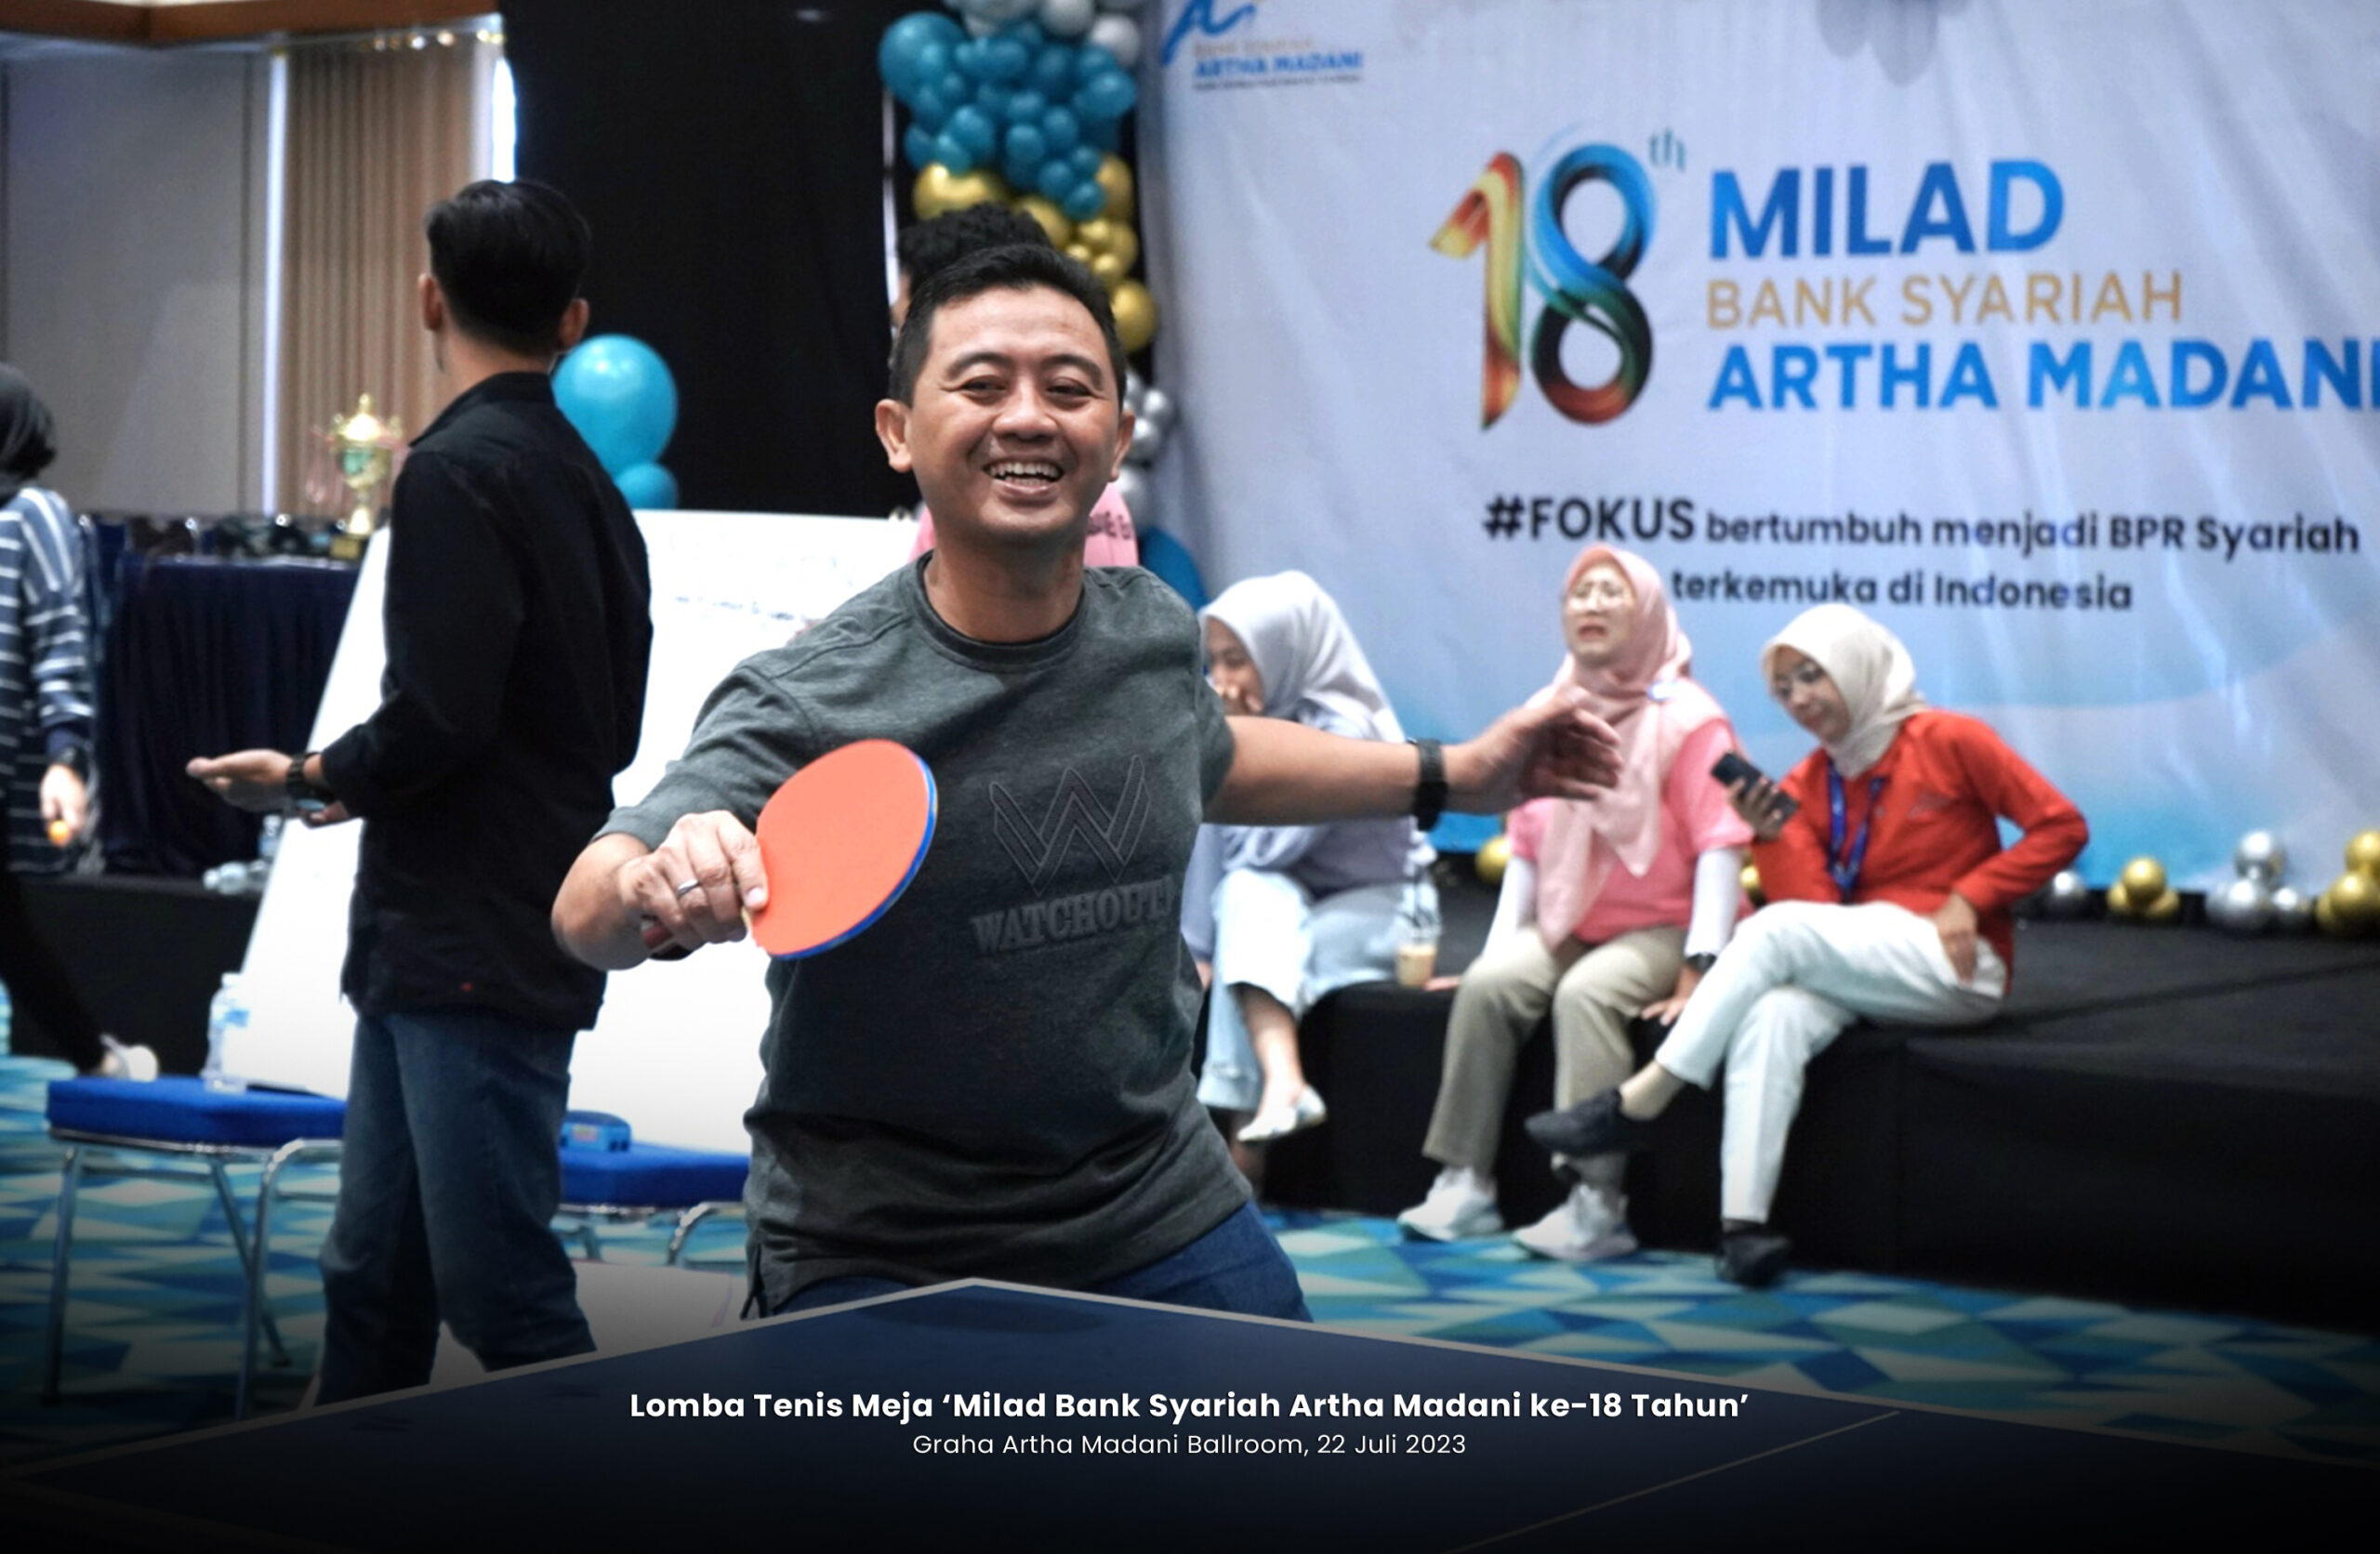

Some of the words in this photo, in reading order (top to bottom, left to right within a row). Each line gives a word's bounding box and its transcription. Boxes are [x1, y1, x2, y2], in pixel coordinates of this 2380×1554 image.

[1710, 160, 2066, 259] MILAD
[1706, 277, 1877, 329] BANK
[1900, 270, 2183, 326] SYARIAH
[1707, 341, 1999, 412] ARTHA
[1483, 494, 1696, 542] #FOKUS
[1707, 512, 1922, 544] bertumbuh
[1932, 512, 2098, 557] menjadi
[2109, 516, 2186, 549] BPR
[2196, 513, 2360, 561] Syariah
[1672, 570, 1877, 604] terkemuka
[1888, 573, 1924, 604] di
[1935, 573, 2133, 610] Indonesia
